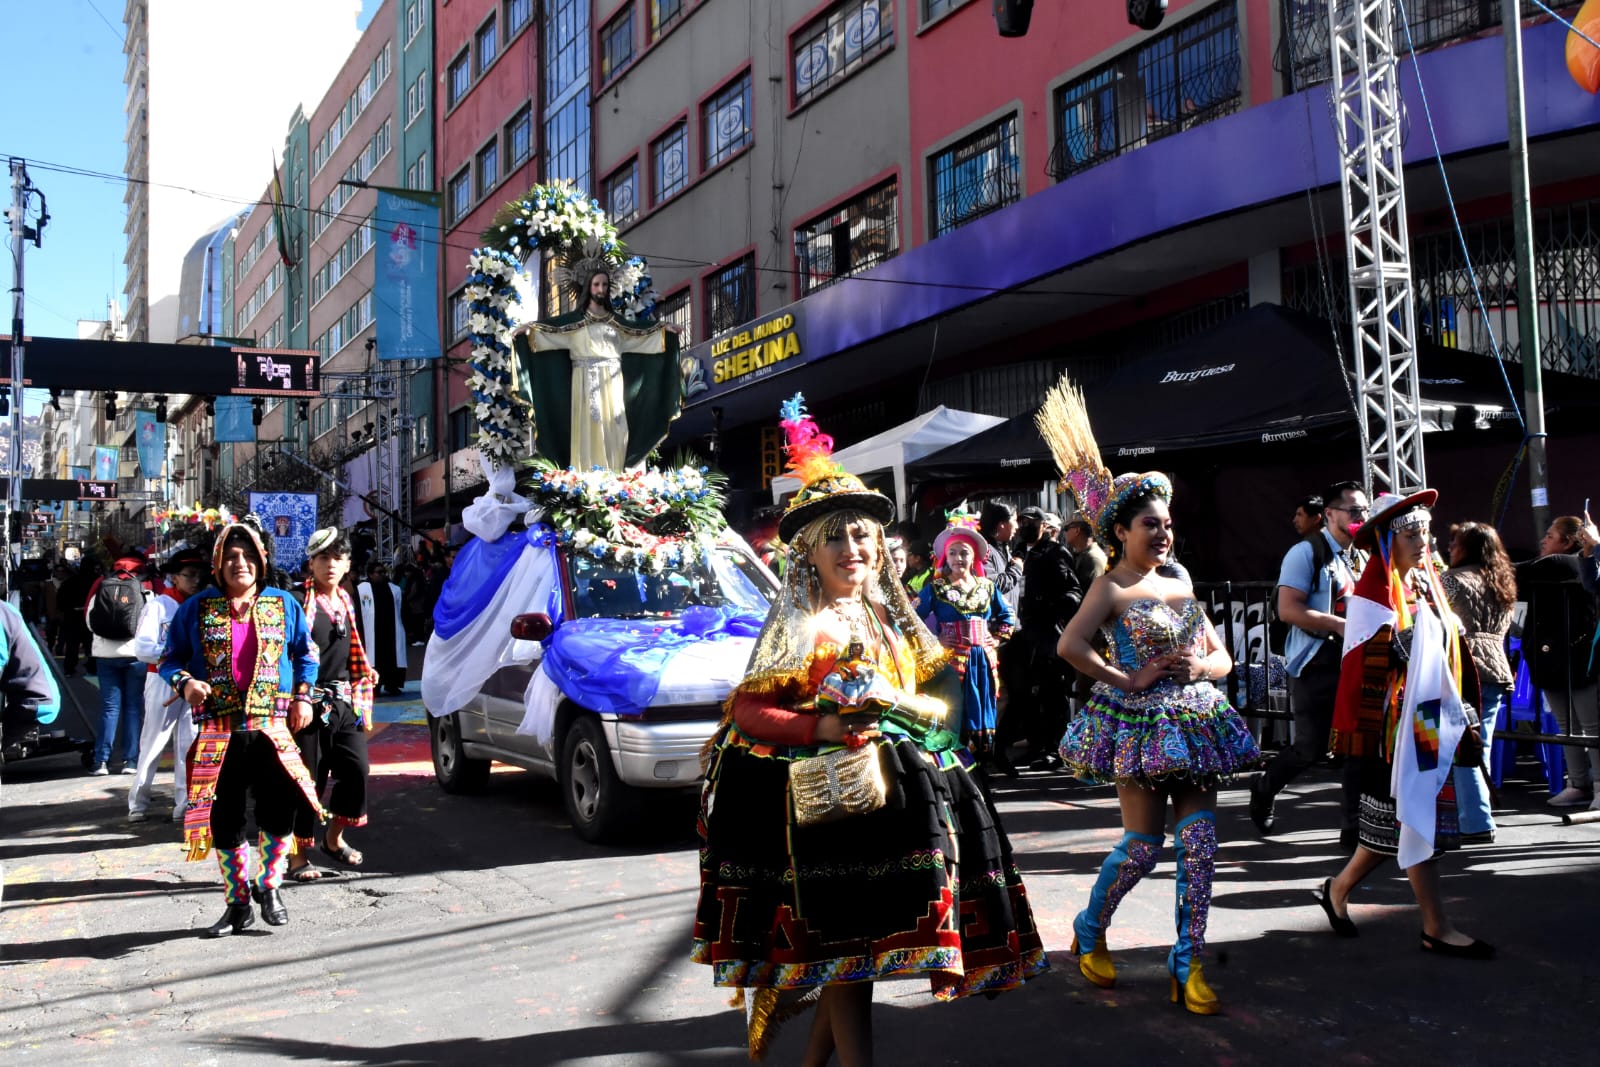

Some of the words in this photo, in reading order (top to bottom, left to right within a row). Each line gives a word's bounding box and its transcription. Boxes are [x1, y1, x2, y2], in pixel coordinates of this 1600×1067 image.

[711, 338, 731, 358] LUZ
[732, 330, 752, 350] DEL
[753, 313, 795, 341] MUNDO
[713, 331, 800, 384] SHEKINA
[1159, 363, 1236, 384] Burguesa
[1261, 429, 1308, 443] Burguesa
[1117, 446, 1156, 457] Burguesa
[1000, 457, 1031, 468] Burguesa
